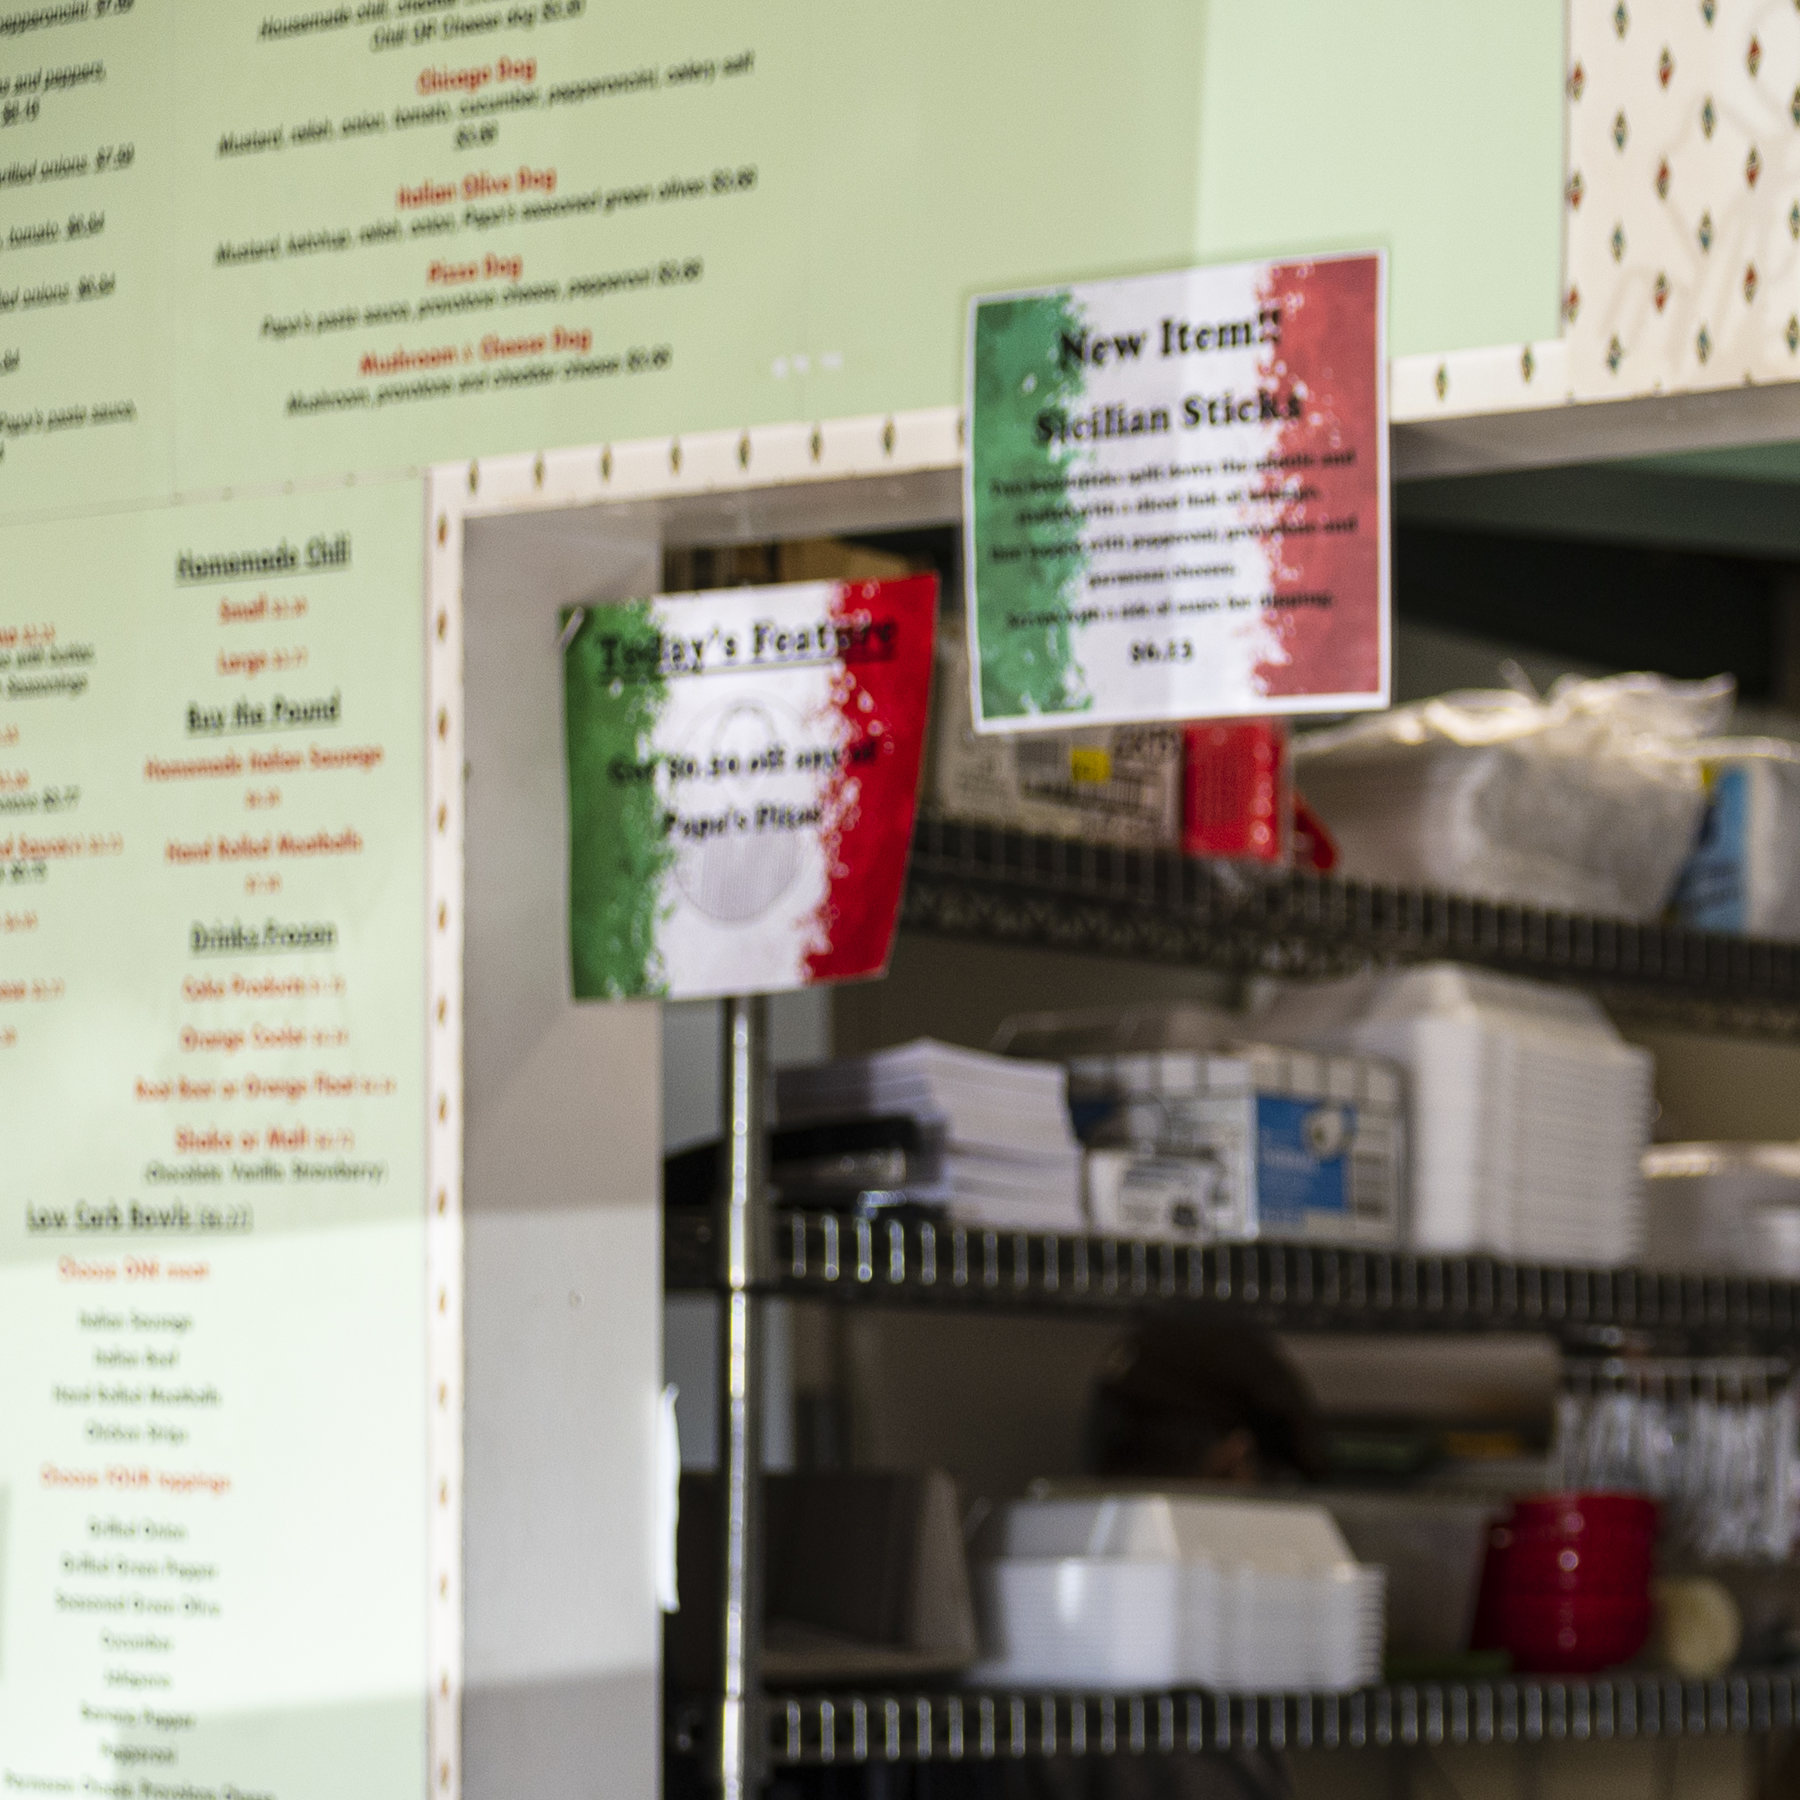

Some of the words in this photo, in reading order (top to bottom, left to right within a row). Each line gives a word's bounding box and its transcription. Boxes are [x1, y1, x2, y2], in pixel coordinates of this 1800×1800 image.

[417, 65, 492, 96] Chicago
[497, 56, 537, 85] Dog
[517, 166, 557, 196] Dog
[483, 253, 523, 283] Dog
[478, 334, 548, 363] Cheese
[552, 325, 593, 356] Dog
[1057, 322, 1147, 371] New
[1159, 309, 1282, 358] Item!!
[1034, 406, 1170, 446] Sicilian
[1183, 391, 1303, 430] Sticks
[175, 538, 298, 582] Homemade
[304, 532, 351, 573] Chili
[600, 626, 736, 673] Today's
[753, 617, 897, 657] Feature
[273, 684, 342, 725] Pound
